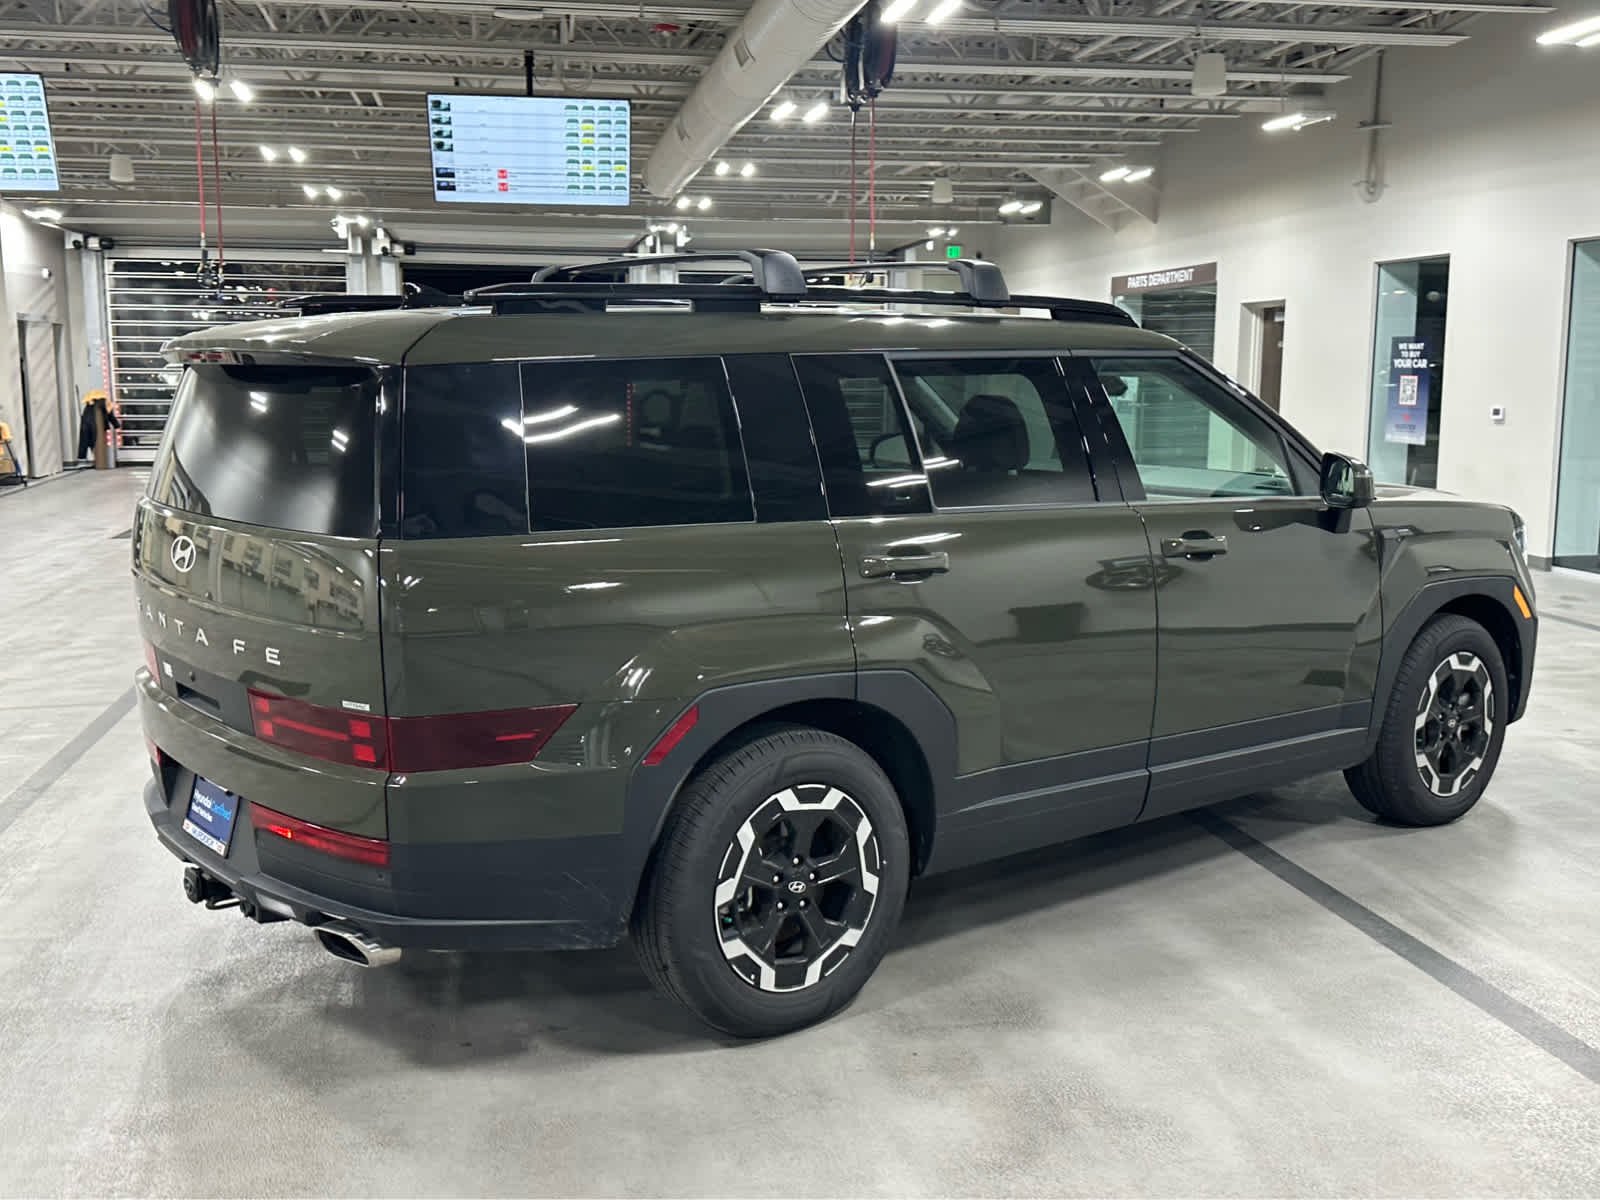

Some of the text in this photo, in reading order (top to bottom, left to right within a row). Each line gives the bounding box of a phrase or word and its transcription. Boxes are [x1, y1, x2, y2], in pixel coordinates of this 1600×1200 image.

[1127, 268, 1194, 288] PARTS DEPARTMENT
[1393, 359, 1428, 369] YOUR CAR
[232, 638, 281, 666] FE
